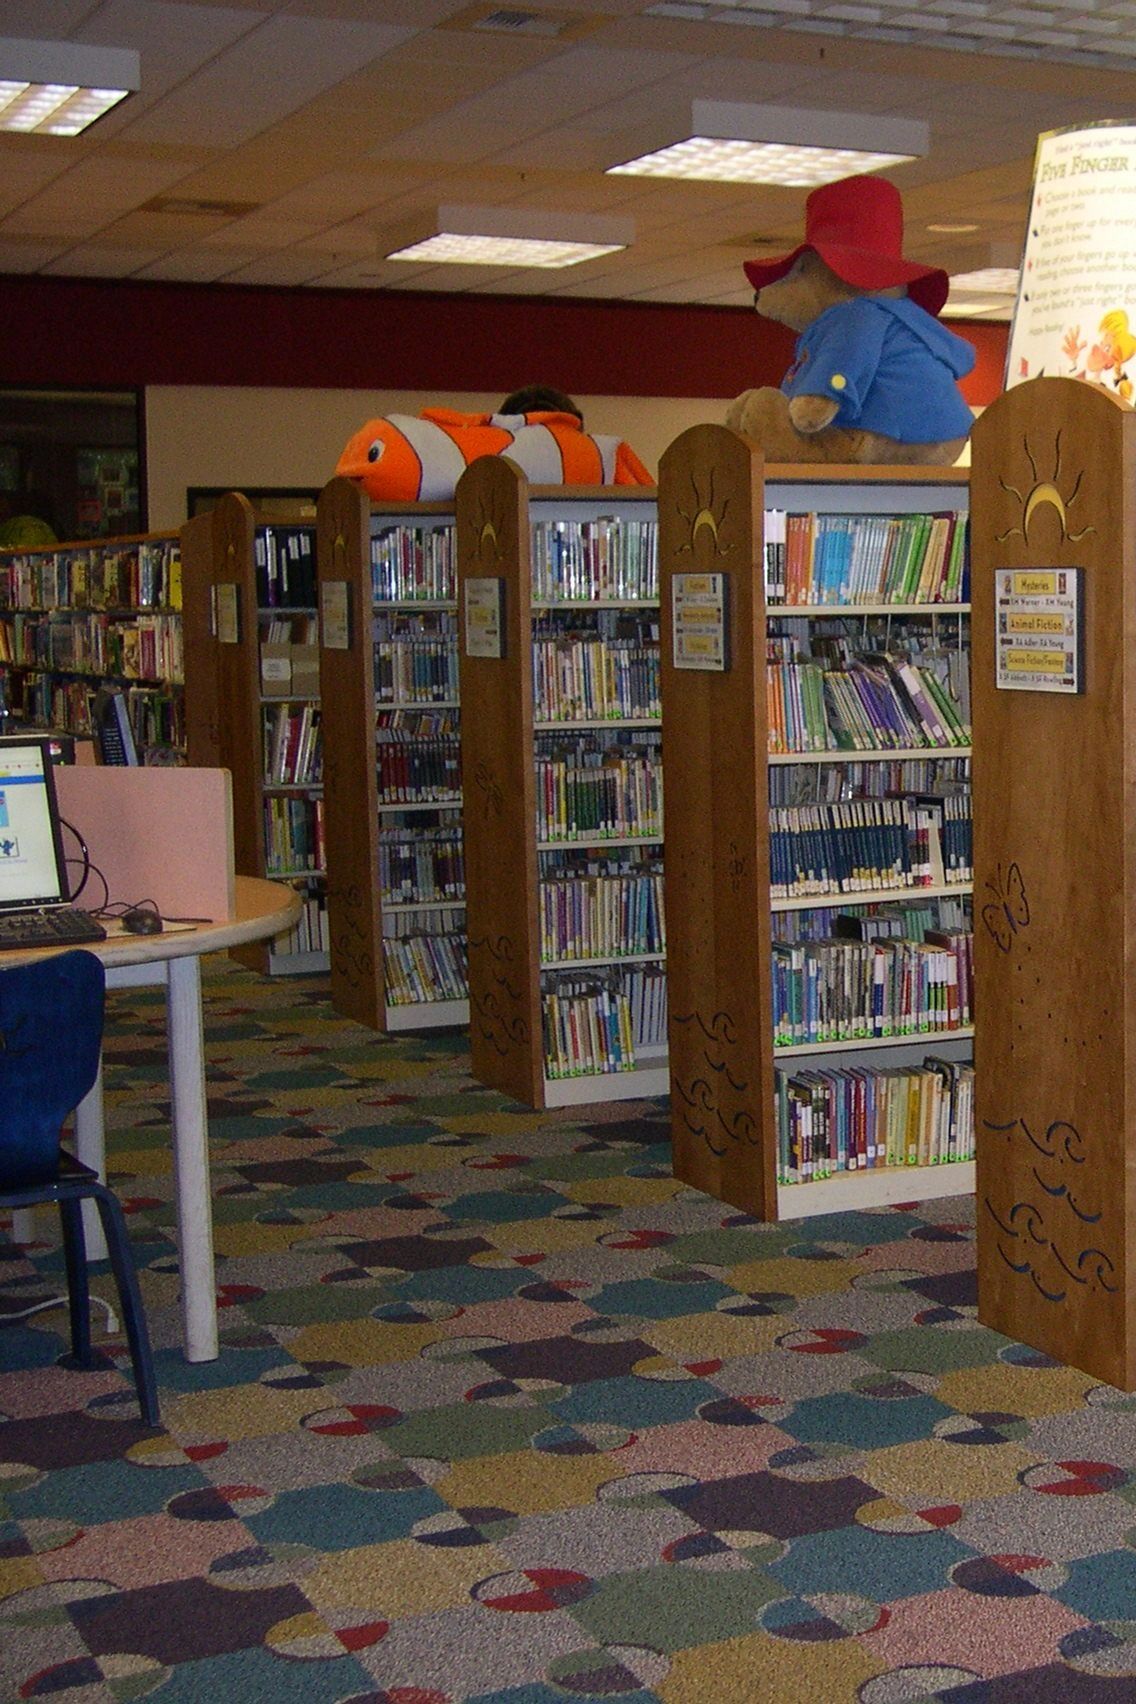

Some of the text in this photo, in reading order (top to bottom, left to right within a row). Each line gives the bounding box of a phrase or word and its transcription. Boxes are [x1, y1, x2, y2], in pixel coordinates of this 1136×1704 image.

[1077, 186, 1096, 196] book
[1100, 185, 1114, 194] and
[1100, 218, 1110, 226] for
[1021, 579, 1050, 591] Mysteries
[1011, 618, 1062, 630] Animal Fiction
